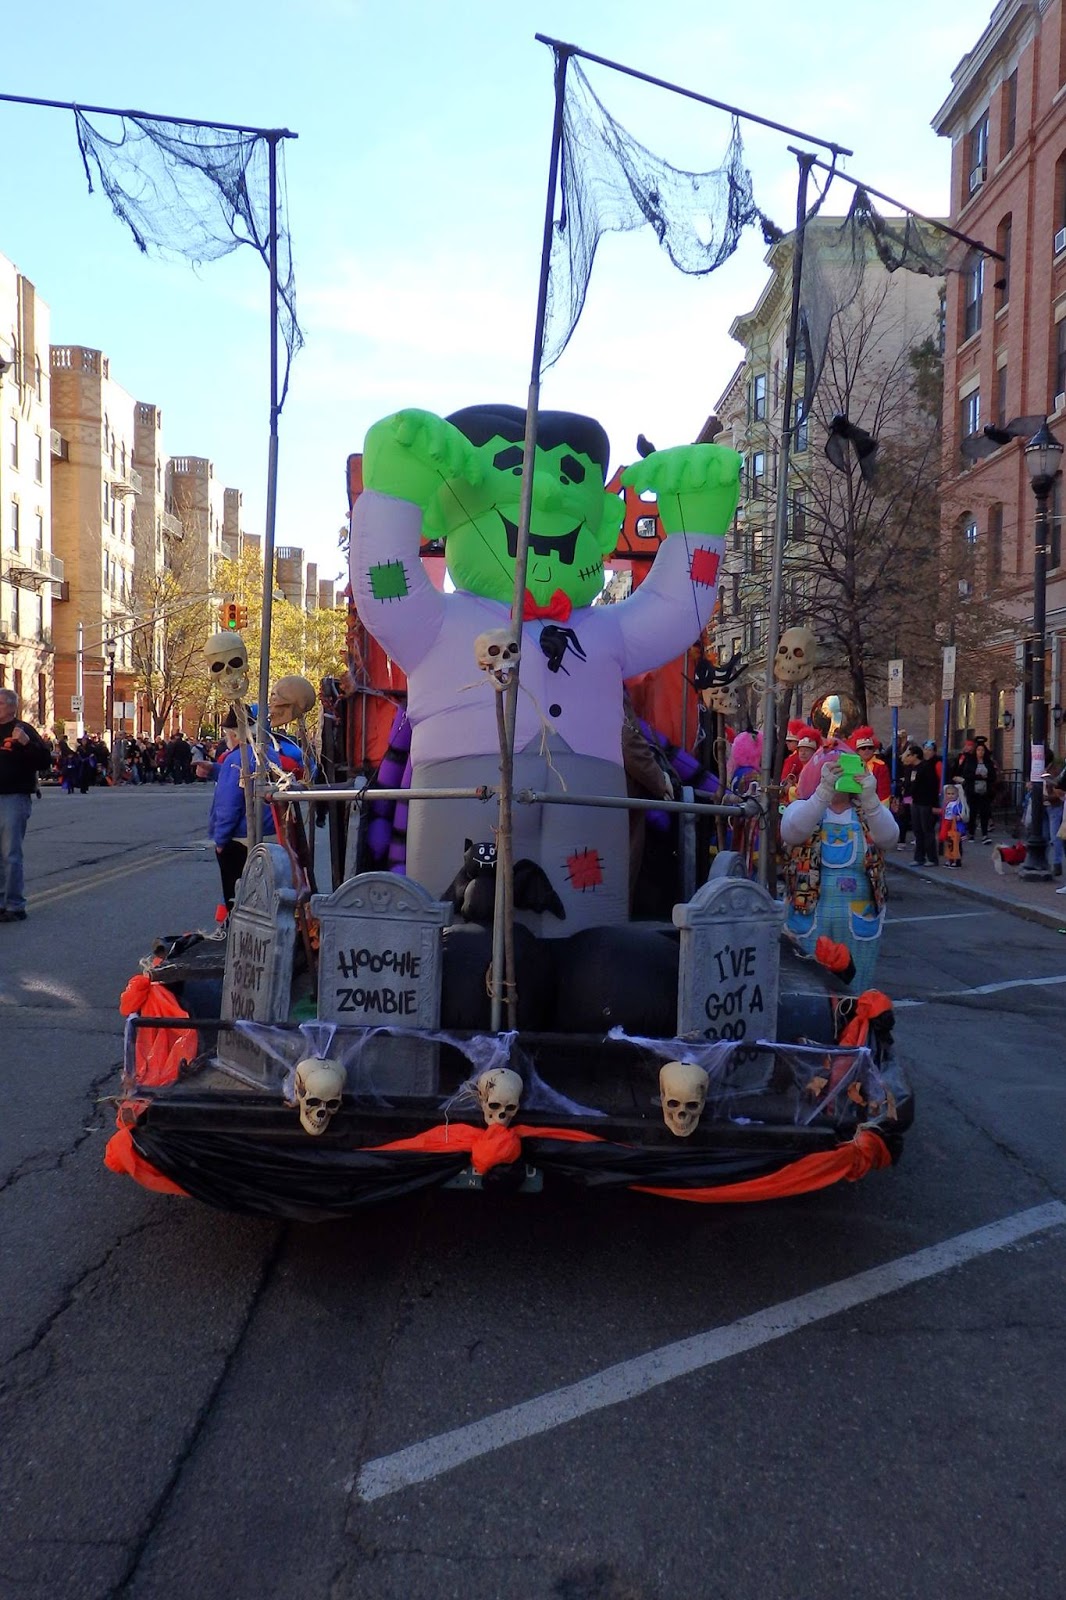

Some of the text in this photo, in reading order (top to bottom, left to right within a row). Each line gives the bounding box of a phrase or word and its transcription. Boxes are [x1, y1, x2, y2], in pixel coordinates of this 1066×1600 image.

[232, 931, 272, 964] I WANT
[336, 948, 422, 979] HOOCHIE
[714, 944, 757, 983] I'VE
[233, 960, 265, 992] TO EAT
[231, 991, 256, 1021] YOUR
[336, 987, 418, 1015] ZOMBIE
[704, 984, 764, 1021] GOT A
